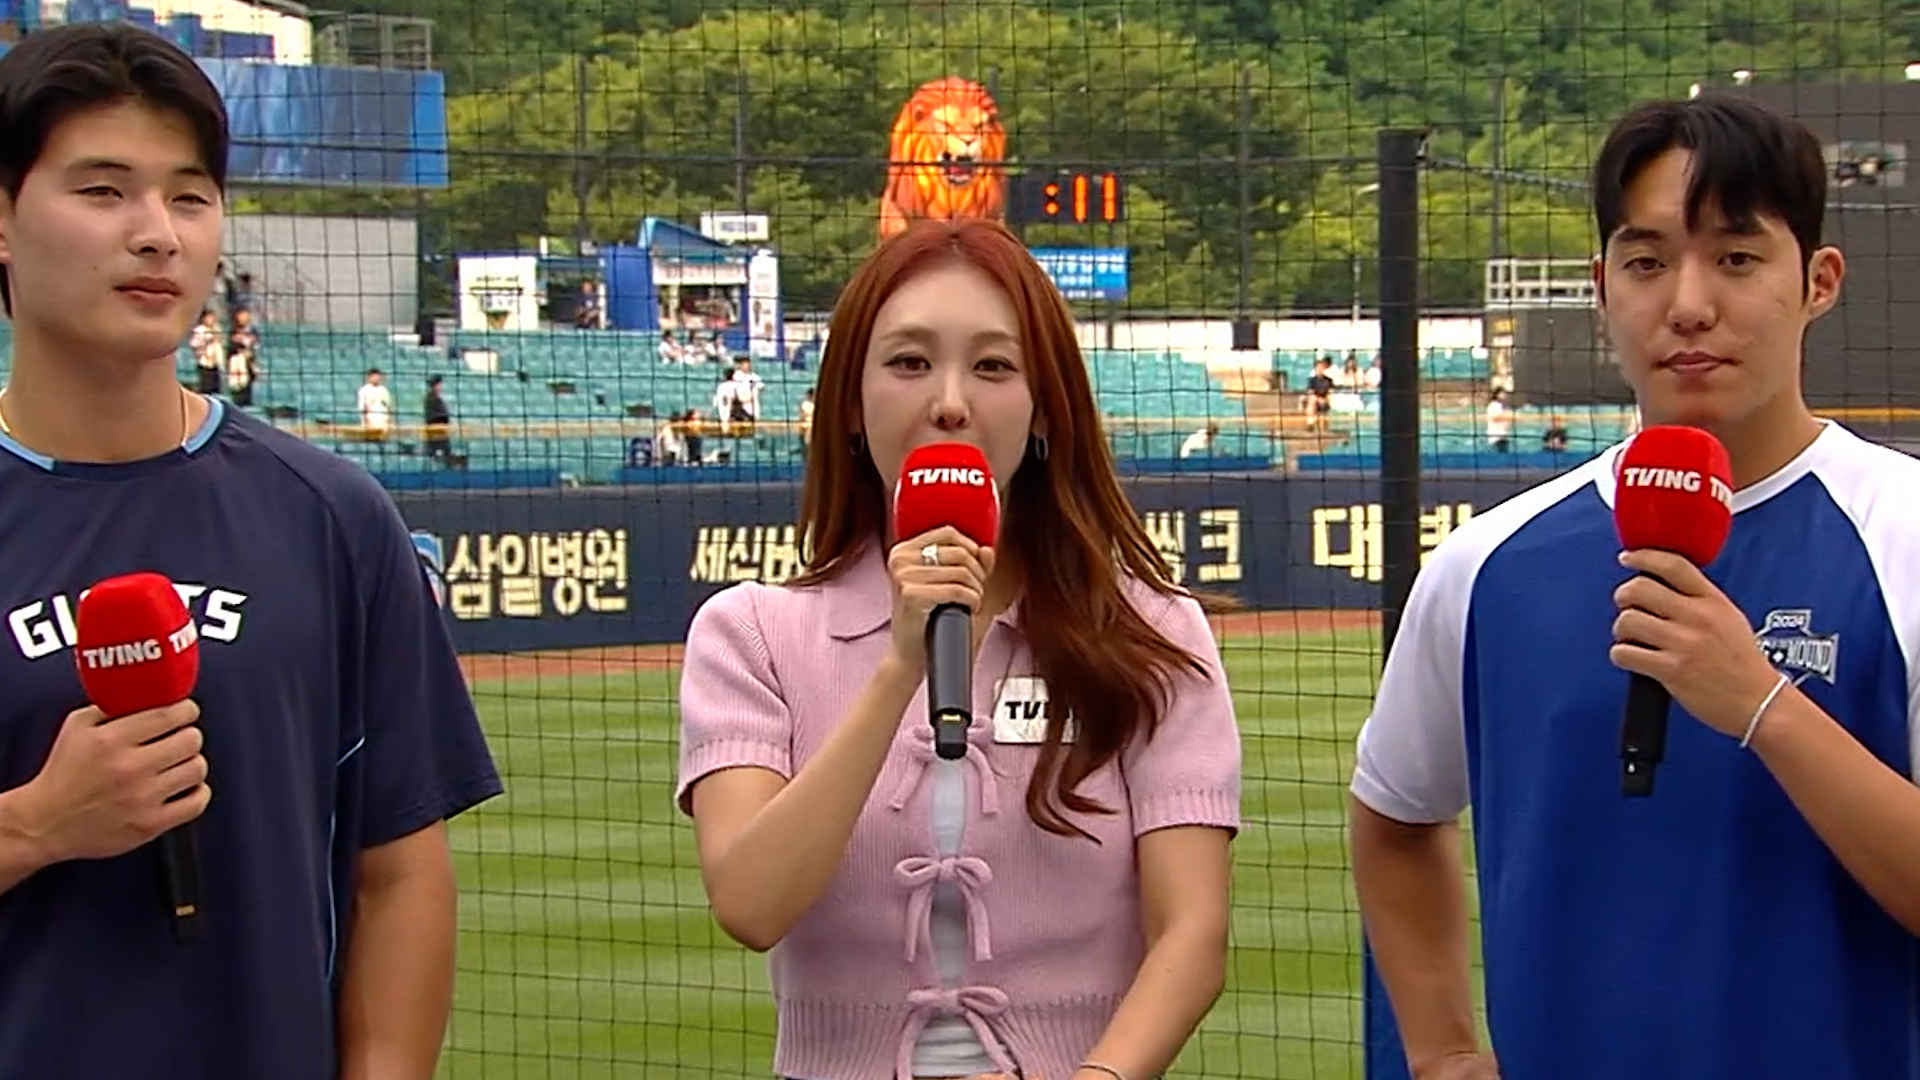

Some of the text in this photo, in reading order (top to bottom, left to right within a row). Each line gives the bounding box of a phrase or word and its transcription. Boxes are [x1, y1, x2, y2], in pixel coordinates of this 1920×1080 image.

[908, 468, 985, 487] TVING
[1624, 467, 1702, 491] TVING
[446, 528, 628, 620] 삼일병원
[8, 582, 248, 659] GITS
[82, 638, 163, 669] TVING
